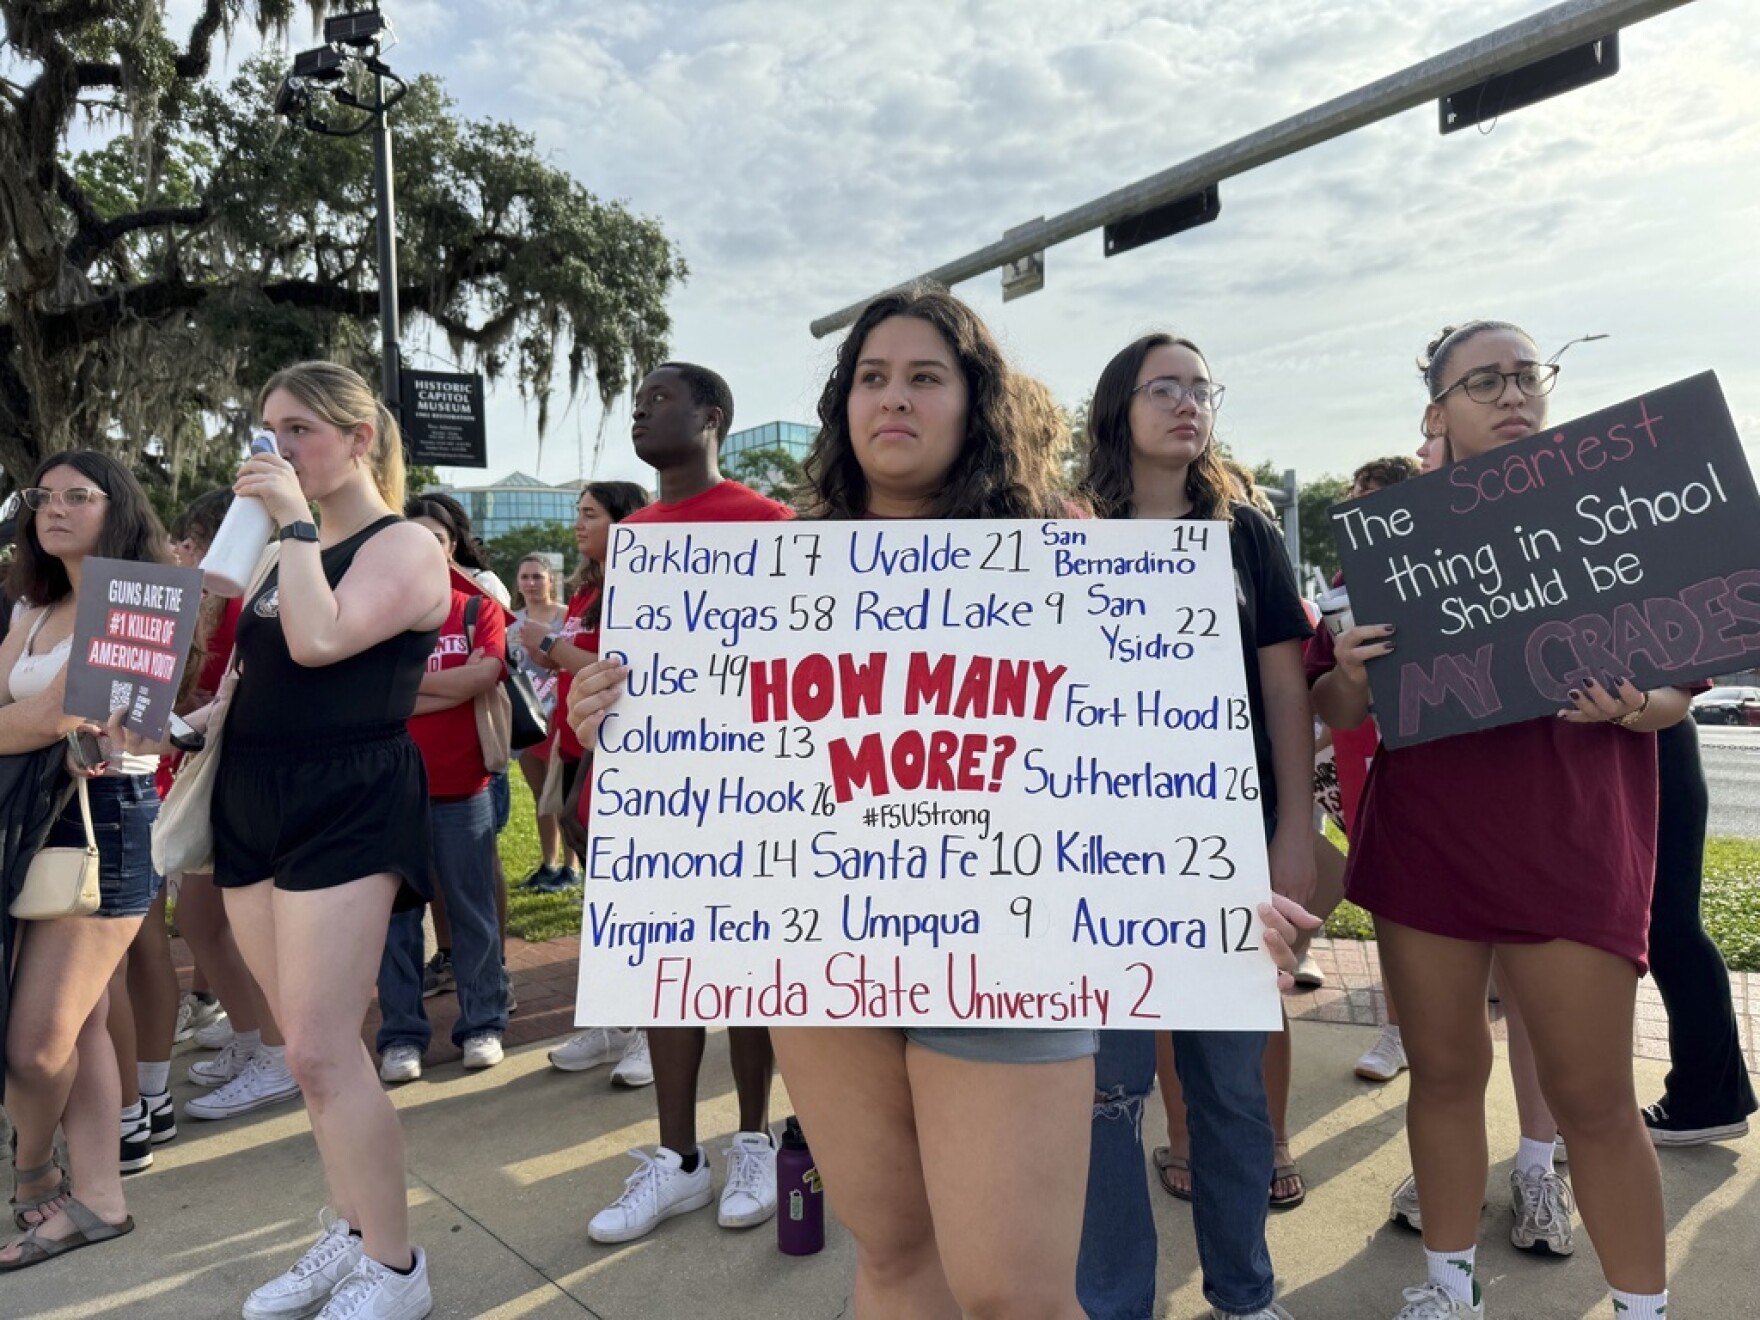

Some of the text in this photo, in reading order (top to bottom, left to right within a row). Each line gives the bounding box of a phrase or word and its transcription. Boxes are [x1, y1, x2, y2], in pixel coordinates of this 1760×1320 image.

[415, 380, 472, 393] HISTORIC
[417, 401, 472, 413] MUSEUM
[418, 391, 469, 402] CAPITOL
[1332, 399, 1664, 552] The Scariest
[611, 528, 822, 577] Parkland 17
[849, 529, 1031, 577] Uvalde 21
[1041, 521, 1087, 546] San
[1171, 525, 1209, 553] 14
[1383, 461, 1729, 602] thing in School
[1055, 550, 1196, 577] Bernardino
[1582, 551, 1645, 594] be
[109, 579, 183, 612] GUNS ARE THE
[606, 585, 672, 632] Las
[683, 590, 778, 647] Vegas
[789, 594, 836, 632] 58
[855, 588, 1065, 632] Red Lake 9
[1087, 583, 1147, 618] San
[109, 611, 175, 644] #1 KILLER OF
[1100, 624, 1195, 662] Ysidro
[1176, 606, 1220, 637] 22
[89, 641, 151, 672] AMERICAN
[709, 652, 750, 697] 49
[1398, 569, 1760, 738] MY GRADES
[749, 651, 1068, 725] HOW MANY
[1065, 683, 1250, 731] Fort Hood 13
[599, 712, 816, 759] Columbine 13
[827, 729, 1017, 804] MORE?
[1023, 748, 1259, 801] Sutherland 26
[597, 767, 837, 828] Sandy Hook 26
[862, 801, 991, 840] #FSUStrong
[590, 836, 797, 883] Edmond 14
[811, 831, 1043, 881] Santa Fe 10
[1056, 829, 1237, 881] Killeen 23
[589, 901, 823, 967] Virginia Tech 32
[841, 893, 1032, 949] Umpqua 9
[1072, 896, 1260, 955] Aurora 12
[652, 951, 1162, 1026] Florida State University 2
